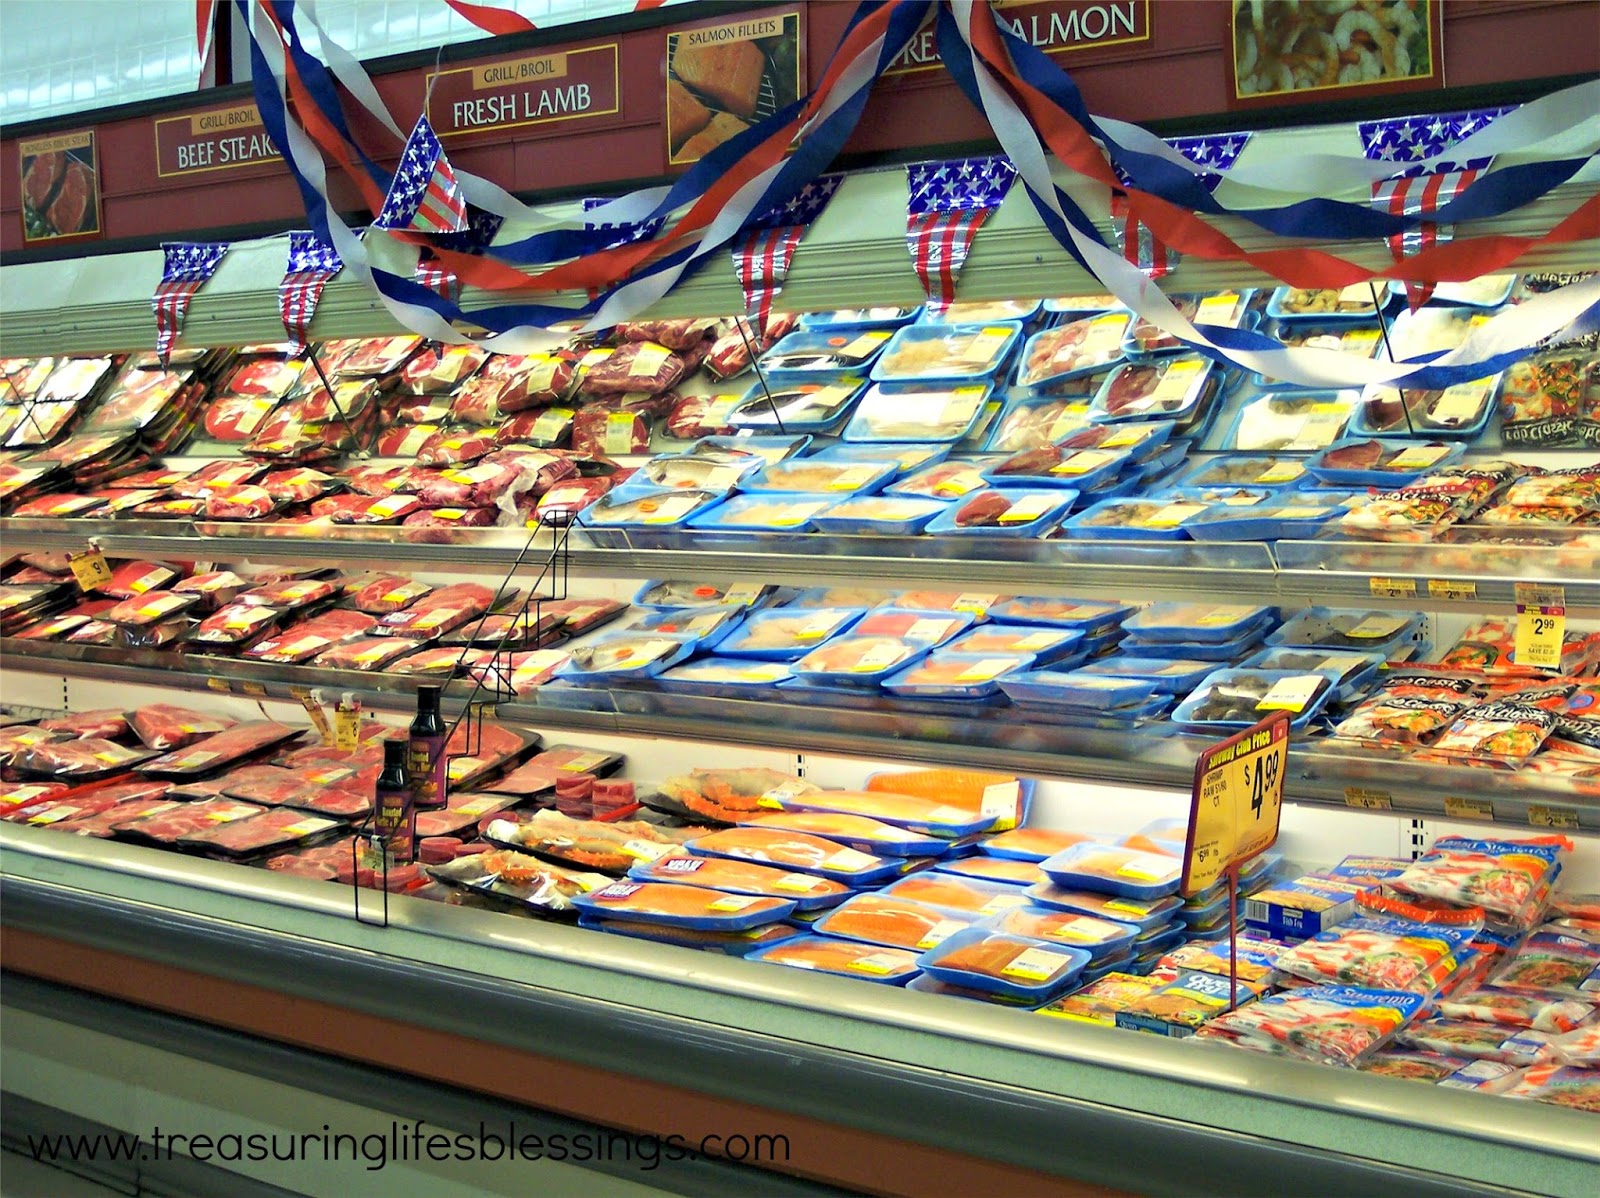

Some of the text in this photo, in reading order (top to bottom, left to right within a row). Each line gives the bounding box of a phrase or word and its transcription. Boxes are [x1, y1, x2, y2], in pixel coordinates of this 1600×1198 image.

[688, 20, 776, 45] SALMON FILLETS
[1012, 1, 1136, 47] ALMON
[483, 59, 556, 84] GRILL/BROIL
[453, 83, 592, 128] FRESH LAMB
[199, 109, 255, 130] GRILL/BROIL
[177, 133, 281, 169] BEEF STEAK
[1252, 729, 1271, 750] Price
